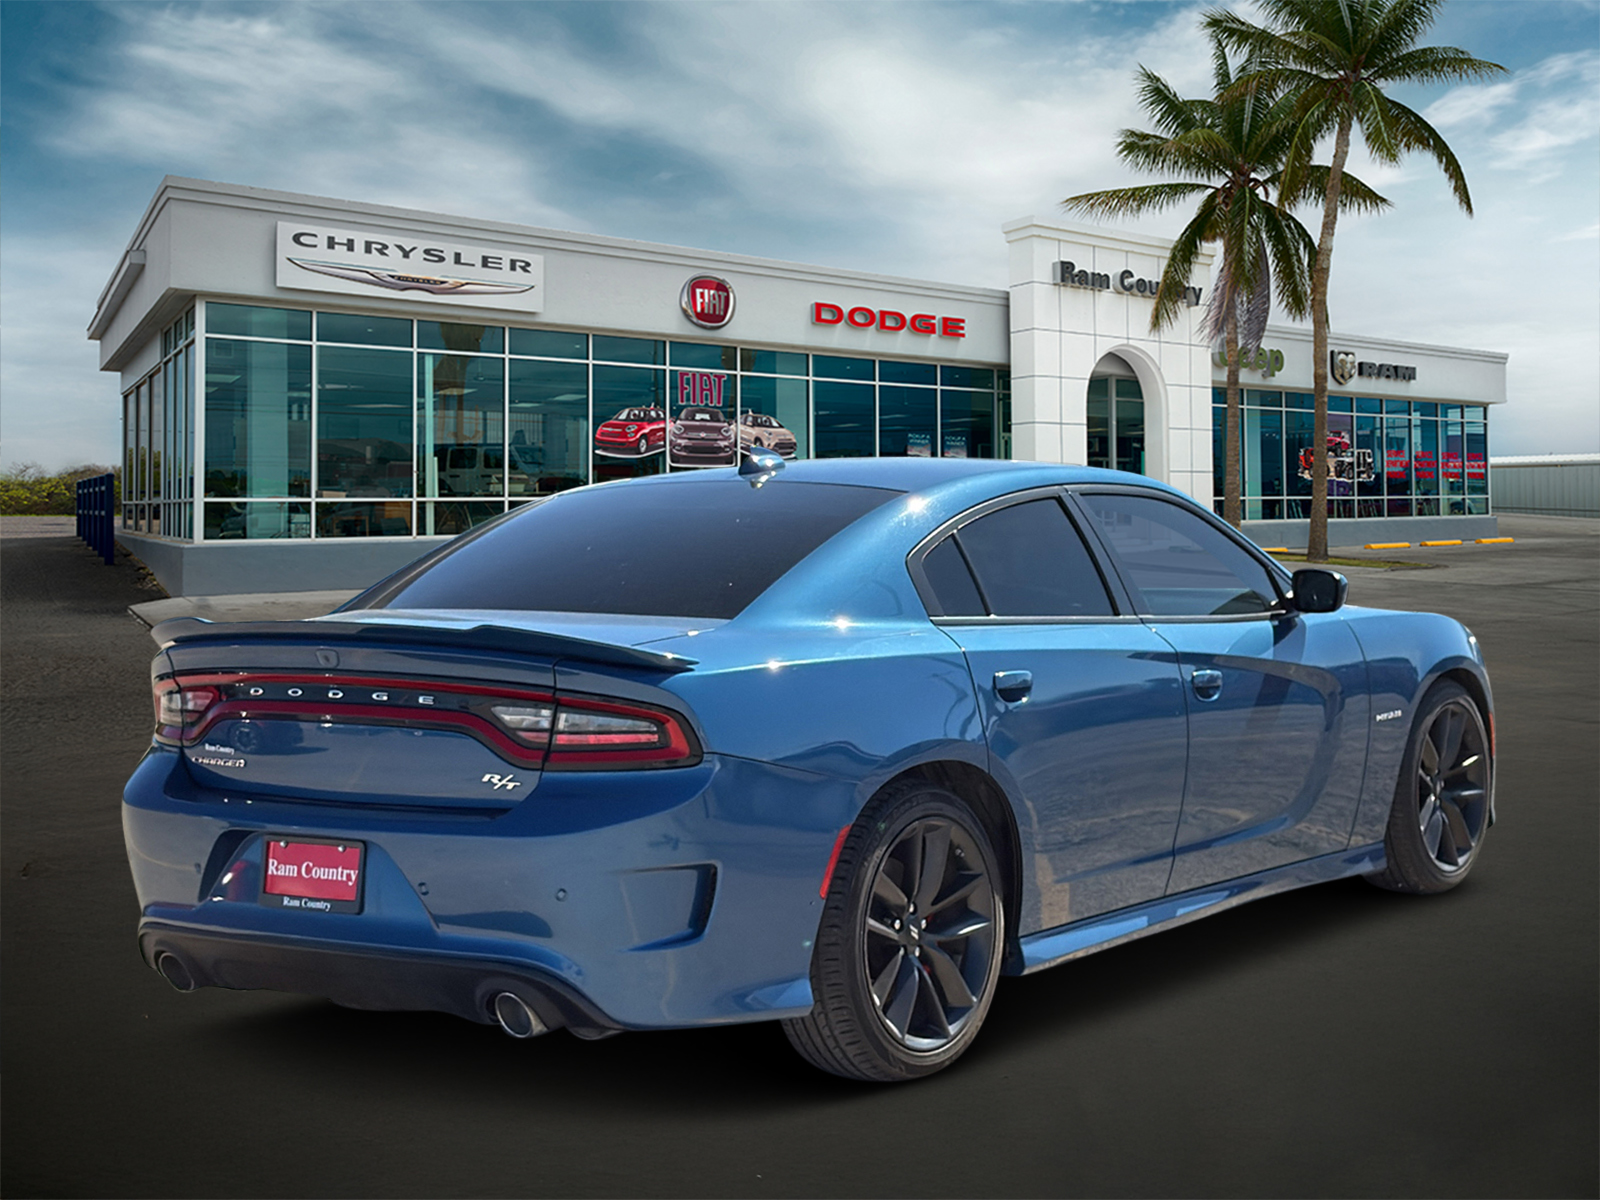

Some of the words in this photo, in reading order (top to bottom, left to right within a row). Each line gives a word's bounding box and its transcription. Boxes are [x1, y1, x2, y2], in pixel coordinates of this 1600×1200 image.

[292, 232, 532, 273] CHRYSLER
[1055, 260, 1110, 291] Ram
[1115, 269, 1203, 307] Coury
[695, 287, 728, 316] FIAT
[812, 301, 967, 338] DODGE
[1358, 361, 1416, 380] RAM
[678, 371, 727, 406] FIAT
[250, 687, 434, 705] DODGE
[192, 756, 245, 767] CHARGER
[481, 773, 521, 790] R/T
[267, 858, 298, 877] Ram
[301, 861, 358, 886] Country
[283, 896, 300, 907] Ram
[301, 898, 331, 912] Country
